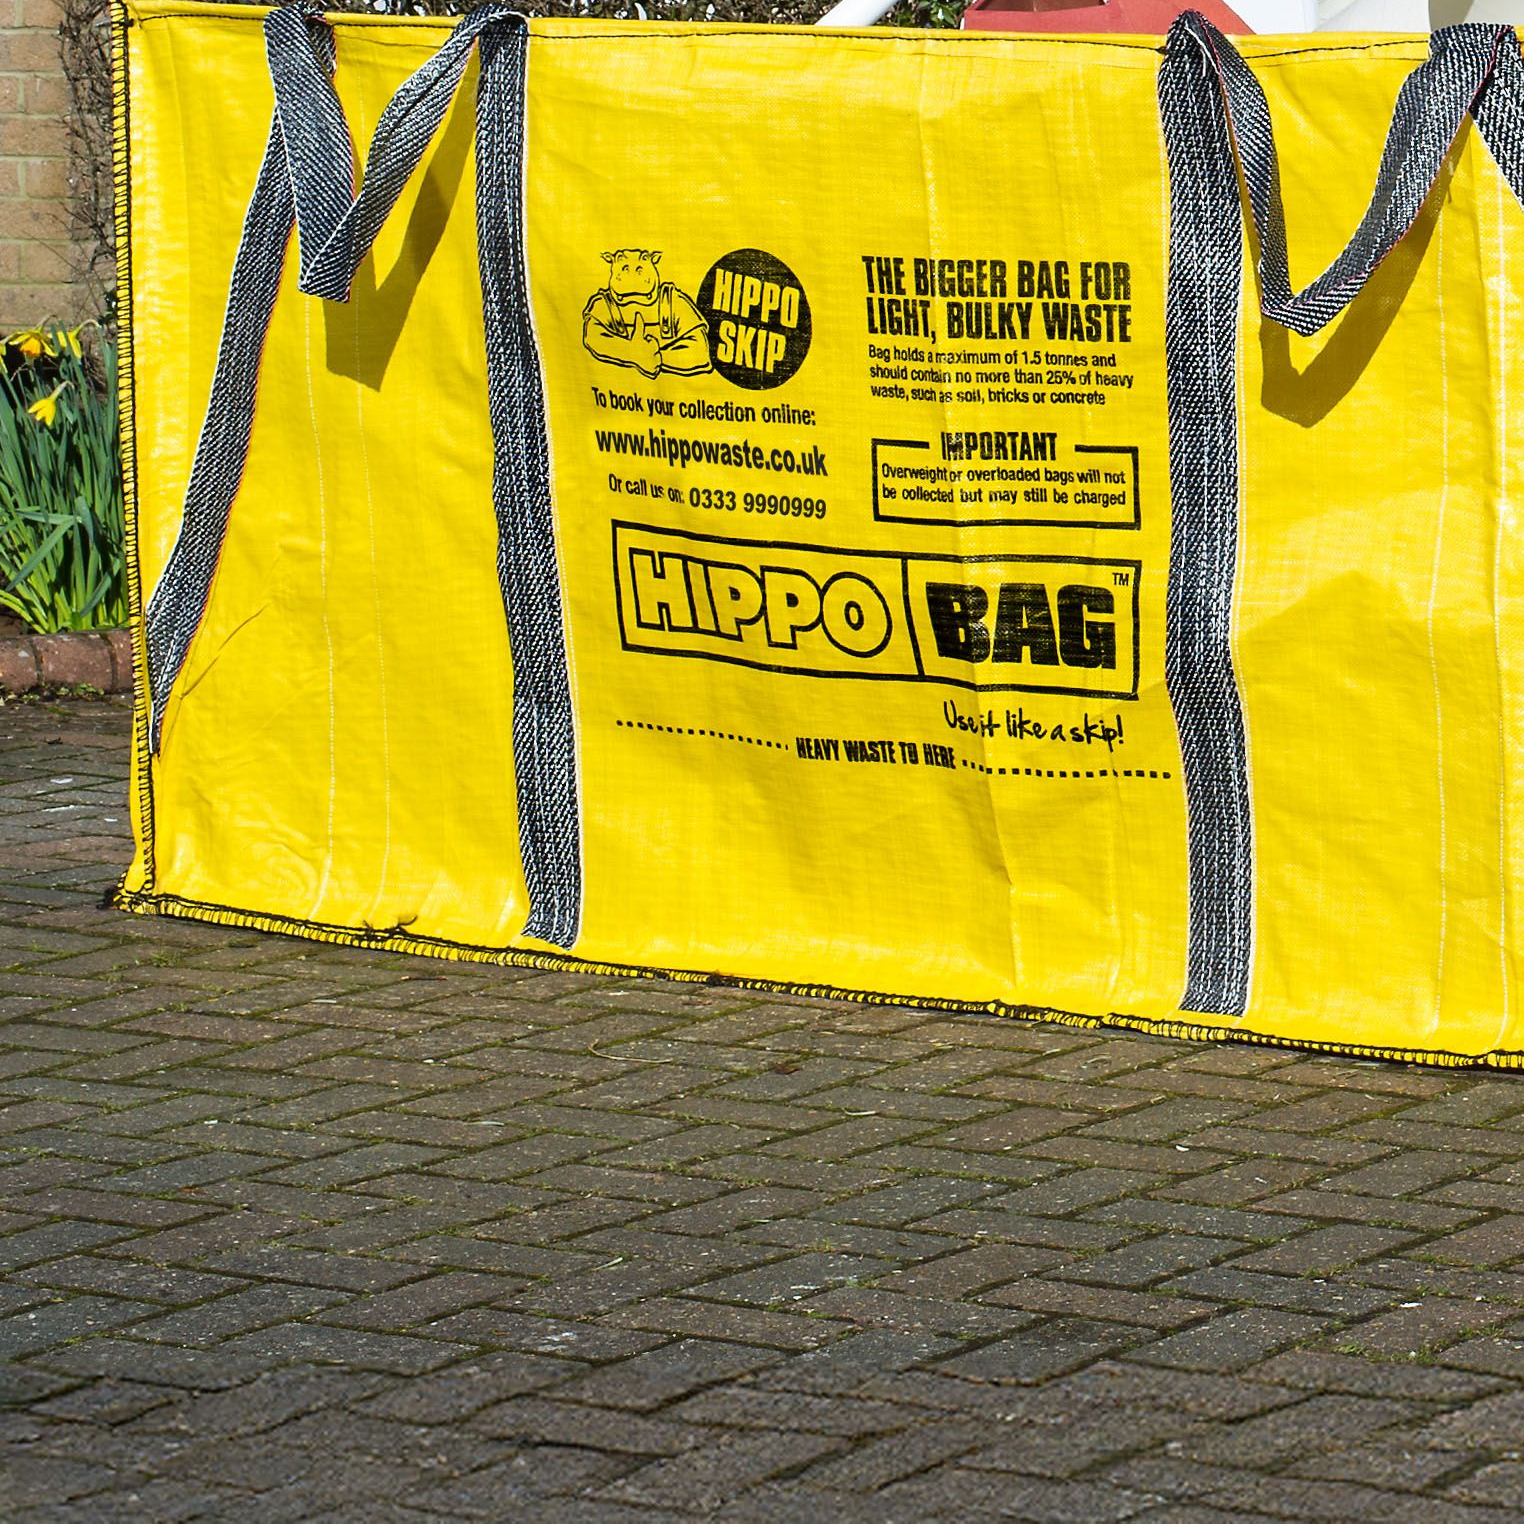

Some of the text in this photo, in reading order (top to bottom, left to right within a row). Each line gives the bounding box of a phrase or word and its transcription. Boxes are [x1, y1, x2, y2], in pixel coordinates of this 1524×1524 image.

[712, 268, 800, 329] HIPPO
[861, 256, 1131, 300] THE BIGGER BAG FOR
[866, 297, 1131, 344] LIGHT, BULKY WASTE
[717, 320, 787, 373] SKIP
[868, 344, 1117, 367] Bag holds a maximum of 1.5 tonnes and
[869, 364, 1134, 388] should contain no more than 25% of heavy
[870, 384, 1106, 405] waste, such as soil, bricks or concrete
[592, 387, 816, 426] To book your collection online:
[595, 428, 829, 477] www.hippowaste.co.uk
[941, 431, 1057, 461] IMPORTANT
[881, 462, 1126, 486] Overweight or overloaded bags will not
[608, 473, 827, 520] Or call us on: 0333 9990999
[882, 483, 1126, 509] be collected but may still be charged
[628, 547, 893, 658] HIPPO
[925, 582, 1116, 670] BAG
[943, 699, 1126, 753] Use it like a skip!
[796, 736, 957, 770] HEAVY WASTE TO HERE
